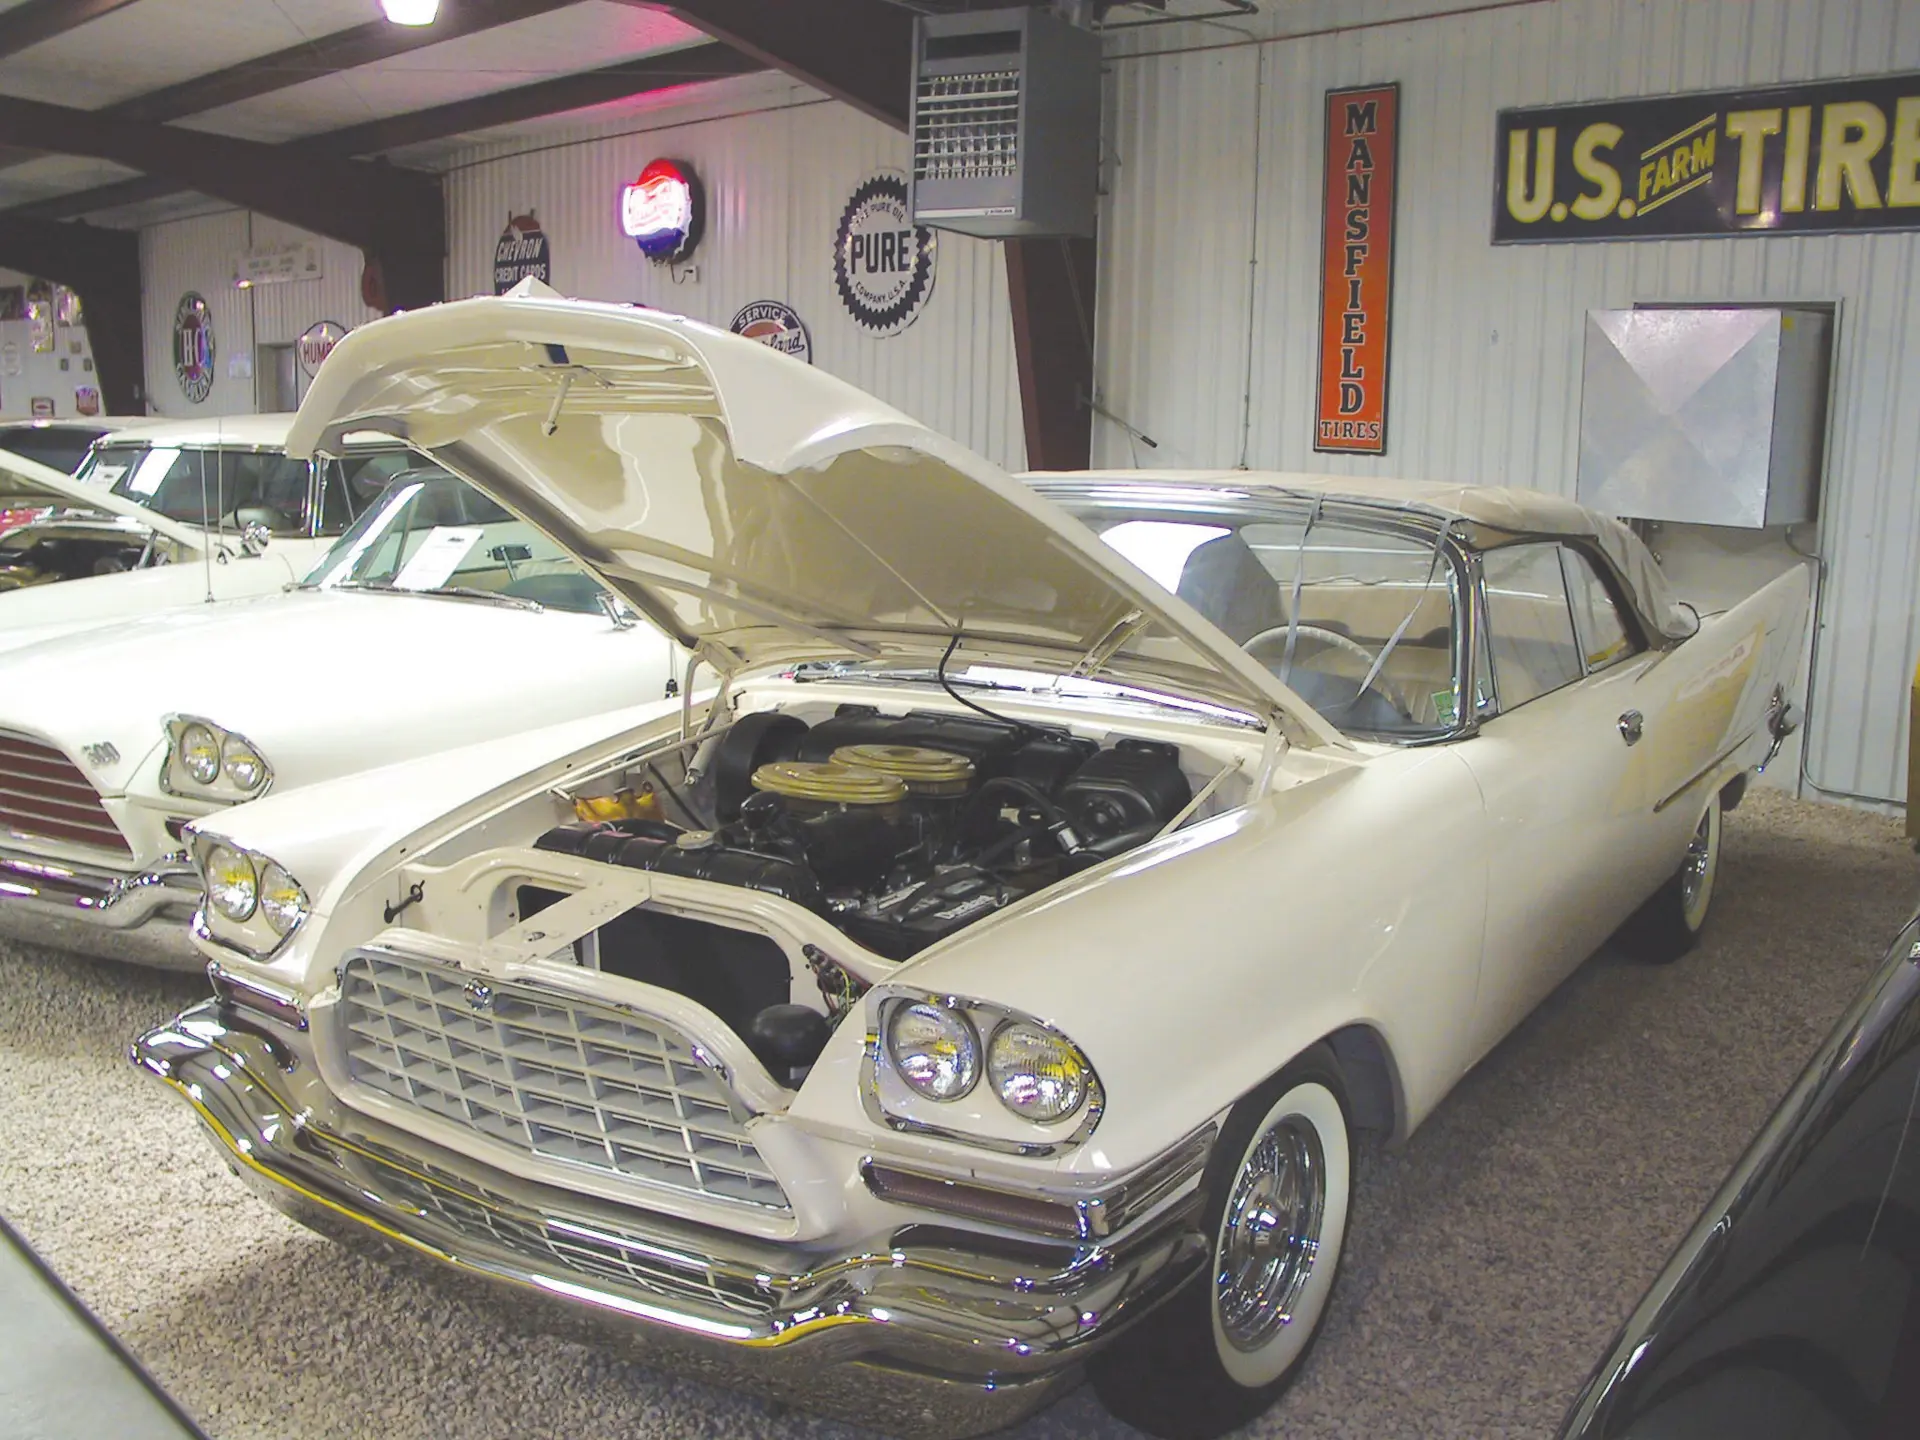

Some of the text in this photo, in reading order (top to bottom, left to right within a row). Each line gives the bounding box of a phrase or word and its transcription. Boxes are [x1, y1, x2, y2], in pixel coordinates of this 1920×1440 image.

[1507, 121, 1636, 223] U.S.
[1638, 128, 1716, 202] FARM
[891, 206, 904, 224] OIL
[497, 238, 543, 261] CHEVRON
[851, 230, 911, 275] PURE
[1339, 101, 1378, 415] MANSFIELD
[495, 266, 519, 282] CREDIT
[738, 307, 788, 328] SERVICE
[1320, 420, 1381, 441] TIRES
